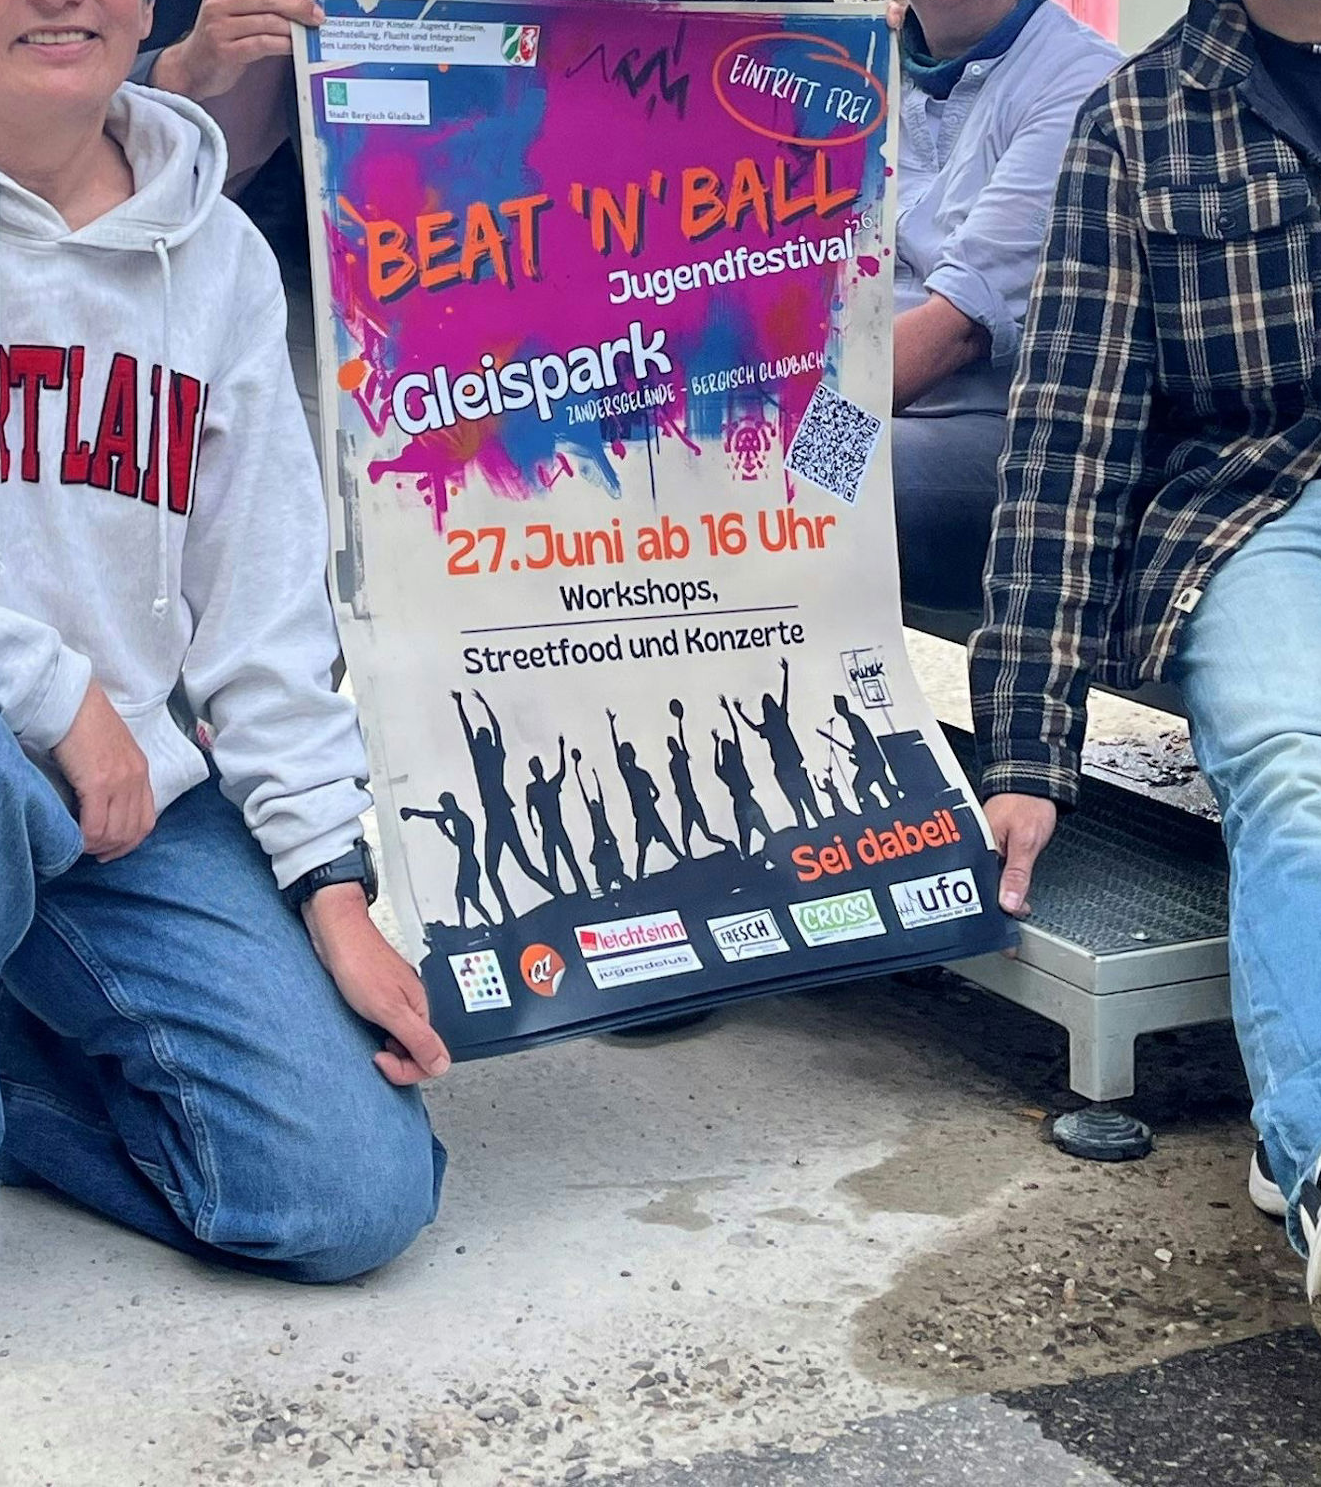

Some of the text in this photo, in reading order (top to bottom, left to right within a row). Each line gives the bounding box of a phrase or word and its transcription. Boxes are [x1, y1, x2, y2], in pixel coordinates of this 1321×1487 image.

[729, 54, 872, 124] EINTRITT FREI
[342, 194, 551, 303] BEAT
[681, 149, 860, 242] BALL
[607, 229, 854, 306] Jugendfestival
[390, 320, 673, 435] Gleispark
[566, 382, 676, 426] ZANDERSGELÄNDE
[691, 365, 756, 396] BERGISCH
[758, 351, 826, 384] GLADBACH
[636, 516, 690, 561] ab
[700, 512, 747, 557] 16
[758, 507, 837, 553] Uhr
[559, 578, 719, 613] Workshops,
[463, 619, 805, 675] Streetfood und Konzerte
[791, 808, 961, 882] Sei dabei!
[802, 896, 870, 930] CROSS
[916, 876, 973, 912] ufo
[597, 921, 685, 950] leichtsinn
[720, 919, 769, 944] FRESCH
